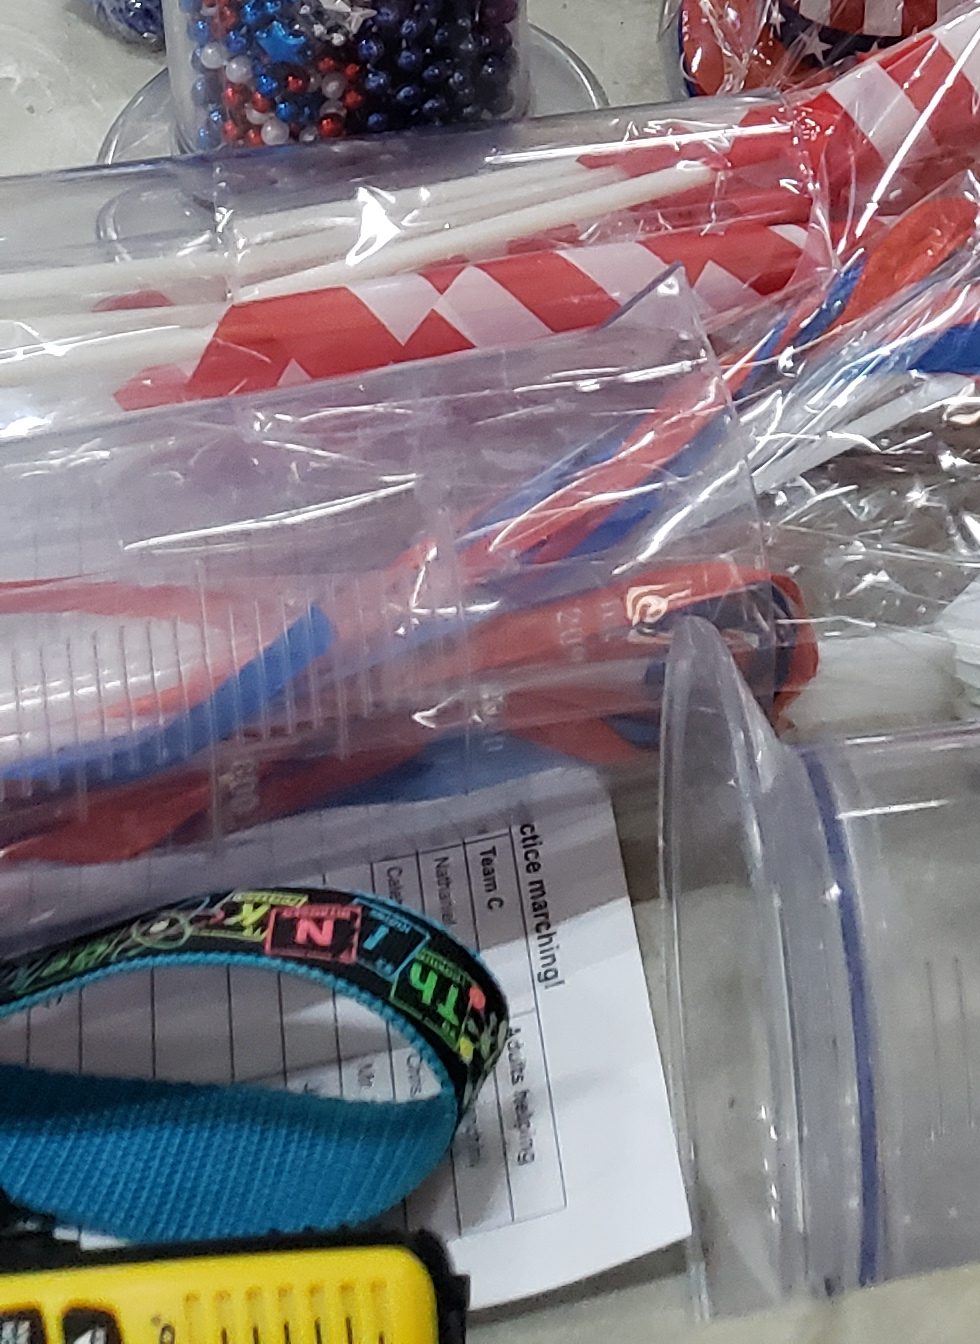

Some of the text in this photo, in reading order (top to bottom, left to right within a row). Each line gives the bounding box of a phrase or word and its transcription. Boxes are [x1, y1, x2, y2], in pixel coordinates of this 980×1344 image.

[386, 865, 404, 905] Cale
[479, 845, 504, 911] Team C
[519, 822, 566, 990] ctice marching!
